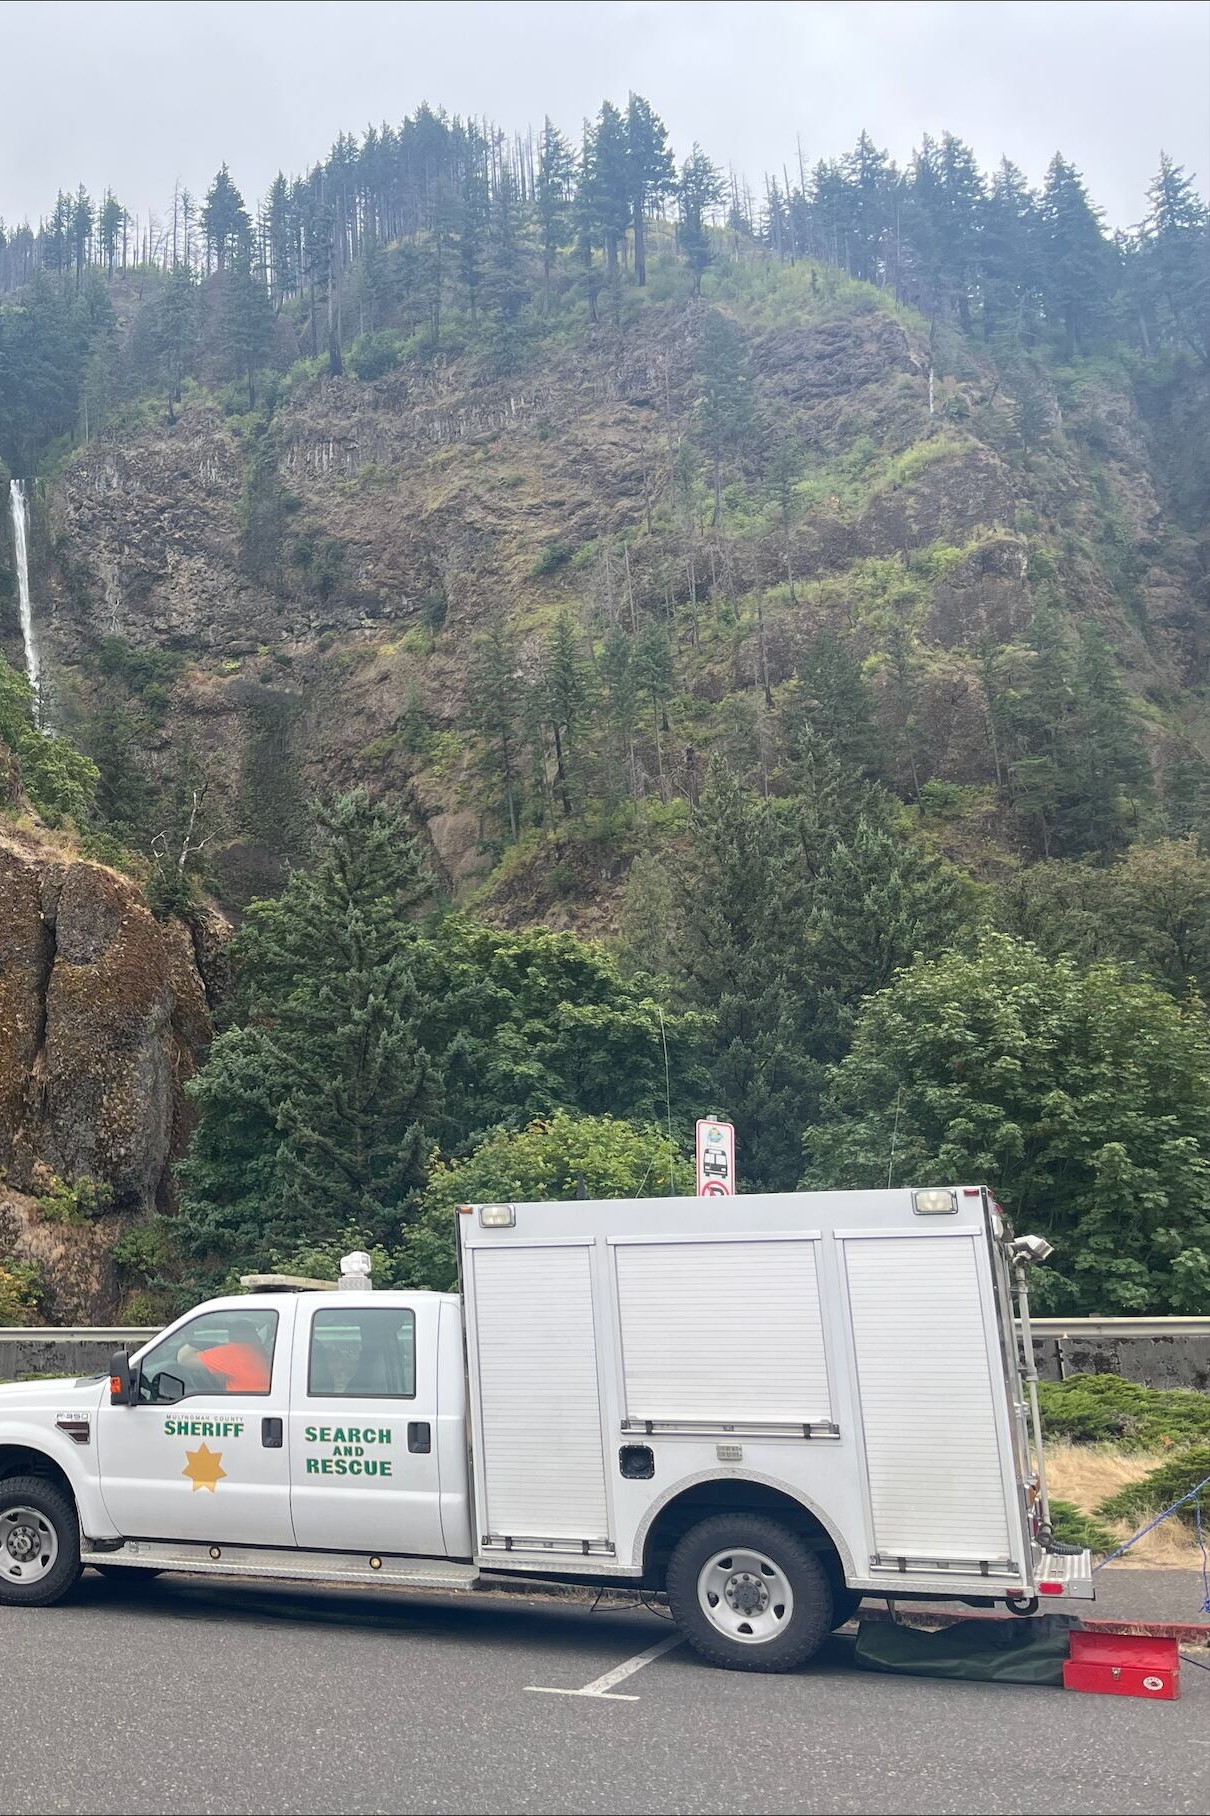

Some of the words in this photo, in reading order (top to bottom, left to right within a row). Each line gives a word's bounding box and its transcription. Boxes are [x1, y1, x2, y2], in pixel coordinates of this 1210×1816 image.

[164, 1420, 245, 1438] SHERIFF
[304, 1426, 392, 1444] SEARCH
[332, 1445, 365, 1457] AND
[306, 1458, 393, 1477] RESCUE
